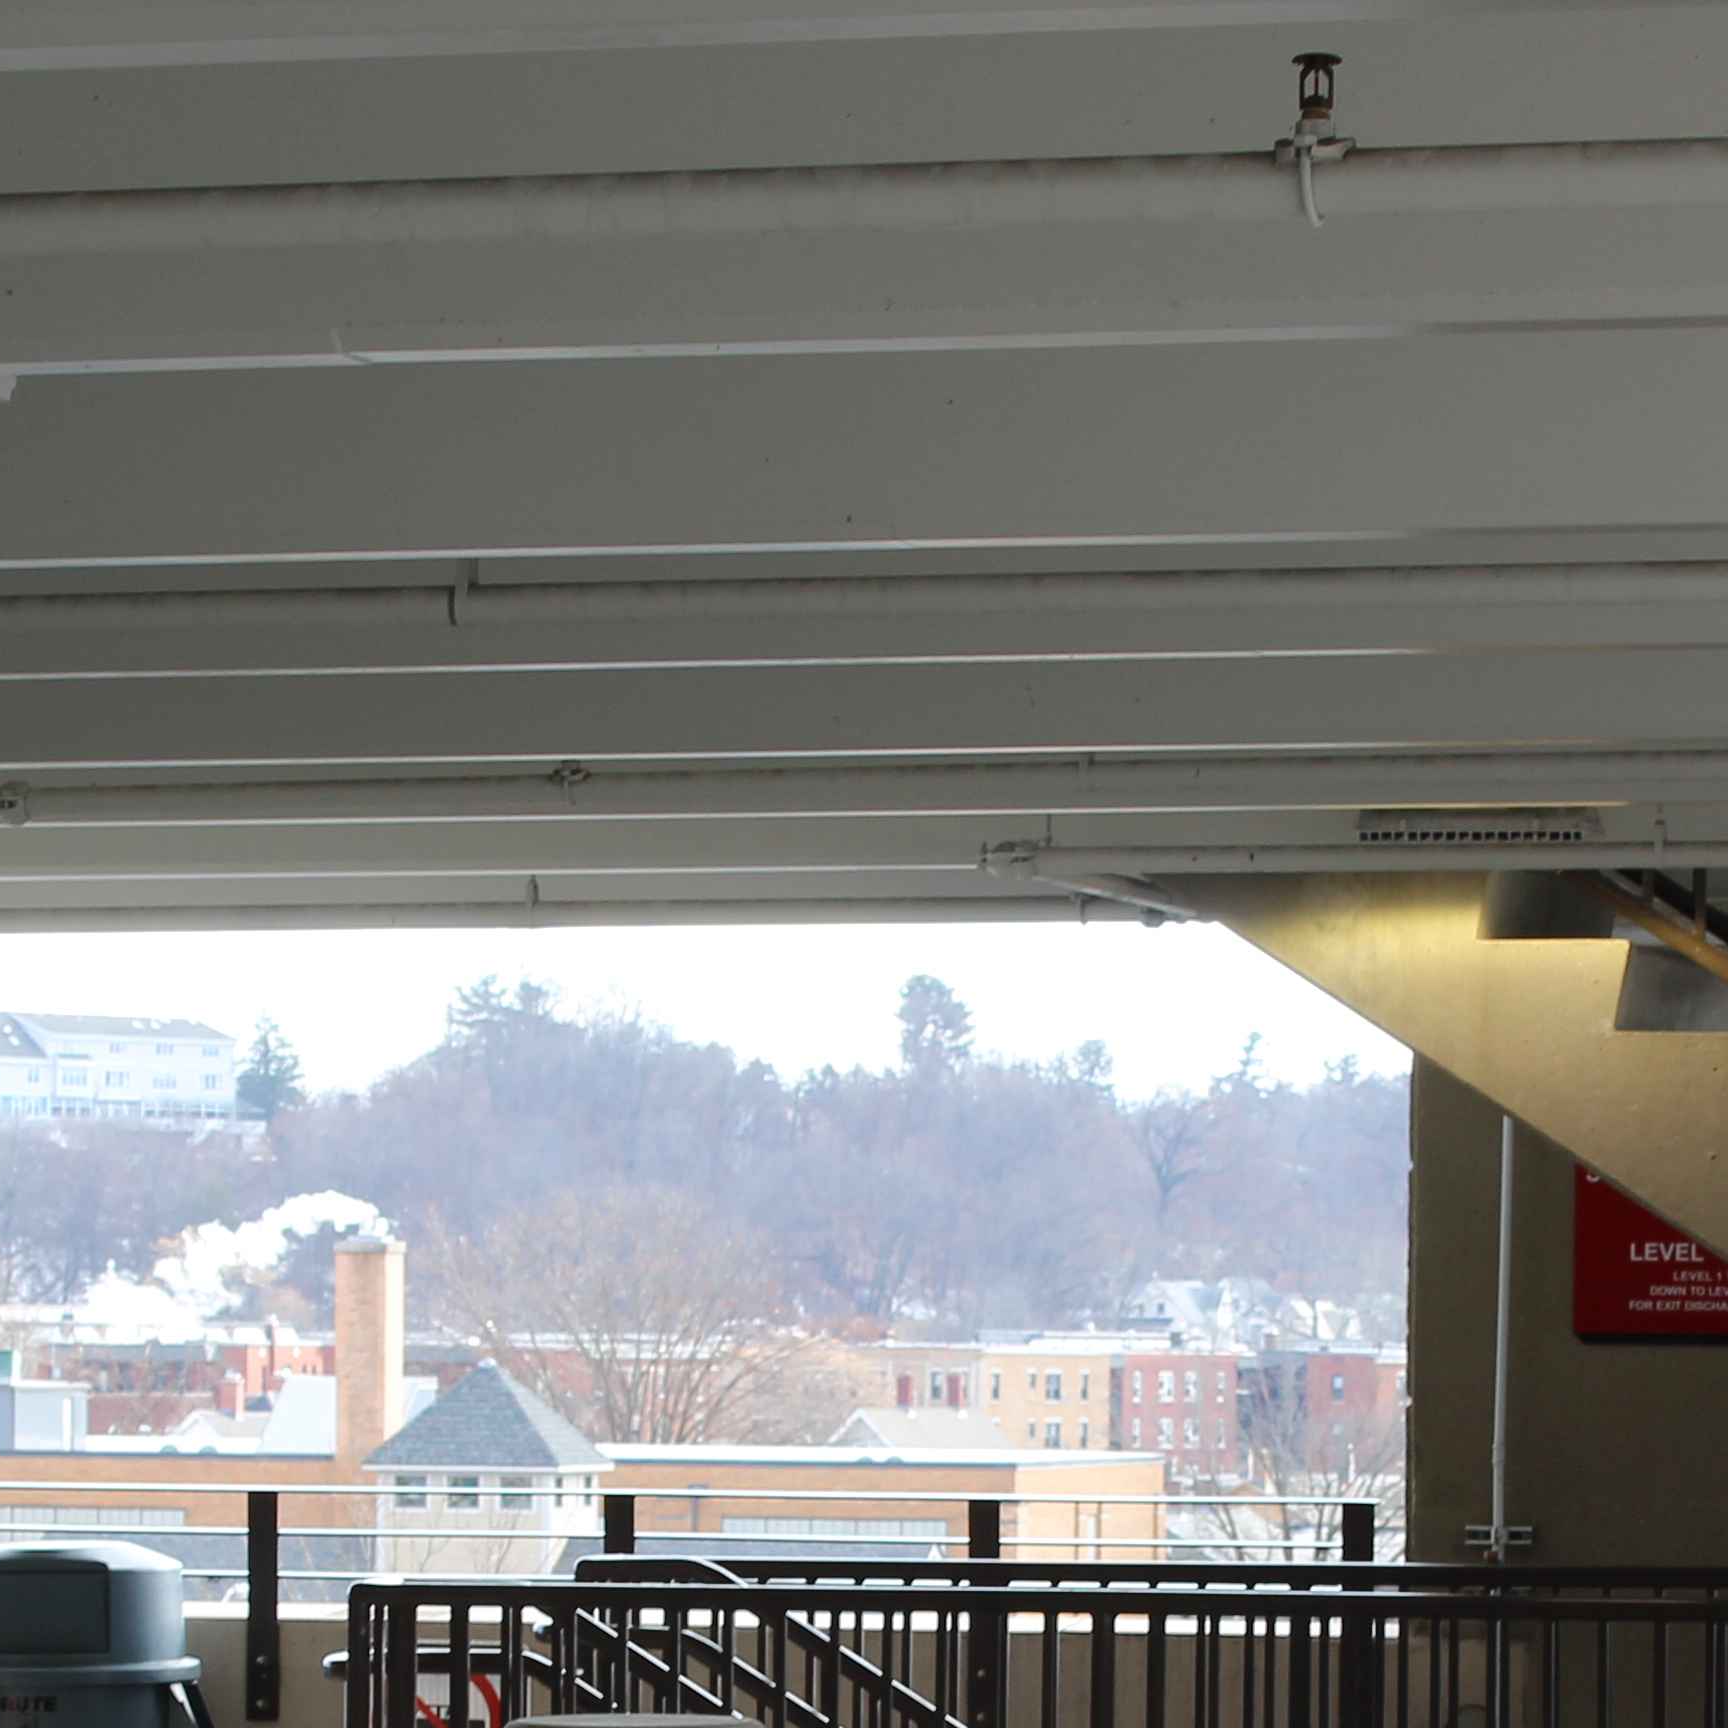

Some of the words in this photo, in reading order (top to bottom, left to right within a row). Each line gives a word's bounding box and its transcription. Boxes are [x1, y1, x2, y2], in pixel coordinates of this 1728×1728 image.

[1630, 1242, 1704, 1262] LEVEL
[1672, 1270, 1712, 1282] LEVEL
[1649, 1285, 1687, 1297] DOWN
[1691, 1285, 1706, 1297] TO
[1629, 1300, 1653, 1312] FOR
[1656, 1300, 1681, 1312] EXIT
